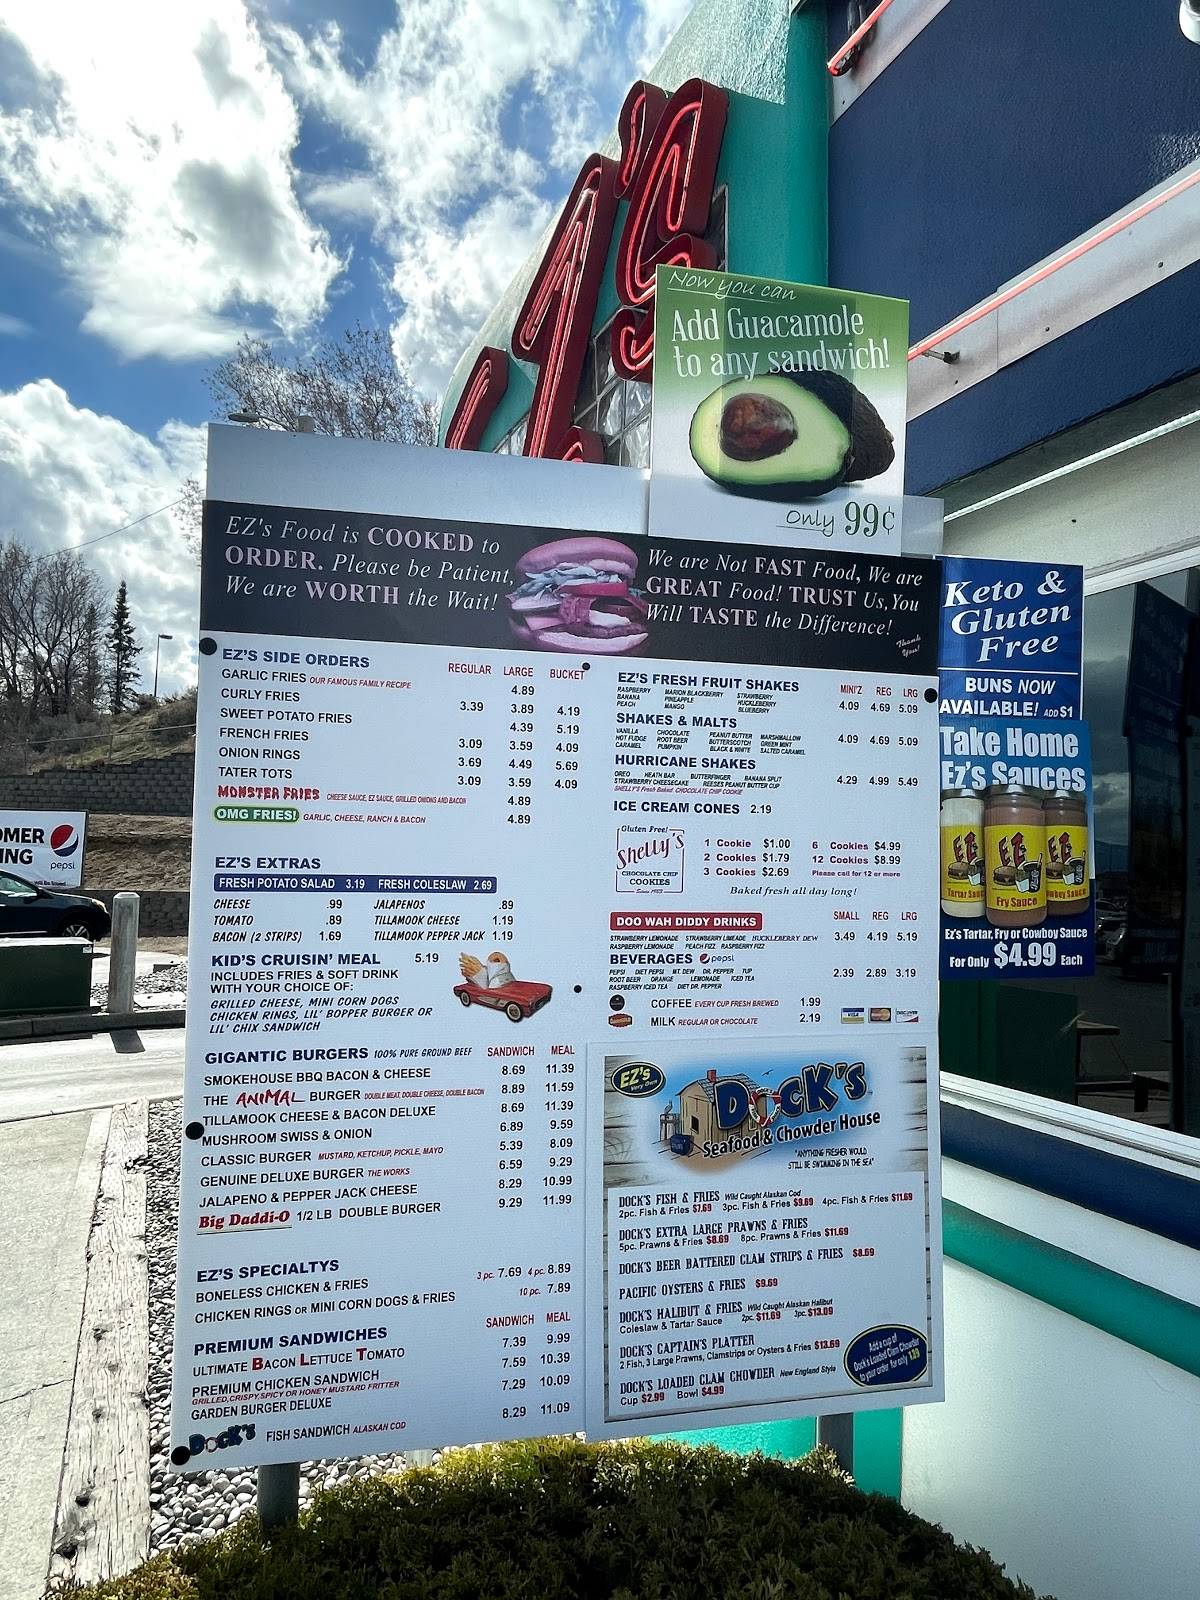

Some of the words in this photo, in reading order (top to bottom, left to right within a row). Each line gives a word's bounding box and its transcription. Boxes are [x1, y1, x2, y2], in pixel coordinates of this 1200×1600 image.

[668, 270, 715, 289] Now
[718, 277, 755, 299] you
[759, 284, 798, 301] can
[671, 309, 720, 342] Add
[727, 304, 865, 340] Guacamole
[674, 348, 701, 378] to
[710, 348, 758, 380] any
[769, 338, 891, 374] sandwich!
[786, 508, 835, 537] Only
[844, 501, 896, 537] 99¢
[224, 515, 272, 539] EZ's
[281, 519, 335, 543] Food
[343, 524, 359, 544] is
[367, 526, 474, 552] COOKED
[481, 536, 501, 555] to
[224, 545, 324, 571] ORDER.
[332, 552, 400, 576] Please
[407, 559, 432, 579] be
[438, 561, 515, 586] Patient,
[648, 549, 673, 568] We
[679, 556, 709, 571] are
[715, 554, 747, 573] Not
[754, 556, 806, 577] FAST
[812, 561, 862, 582] Food,
[867, 566, 891, 584] We
[896, 571, 923, 587] are
[224, 575, 255, 595] We
[262, 583, 298, 598] are
[304, 580, 399, 605] WORTH
[408, 591, 439, 608] the
[448, 589, 499, 611] Wait!
[646, 576, 722, 598] GREAT
[729, 581, 782, 602] Food!
[789, 586, 857, 607] TRUST
[943, 580, 1024, 608] Keto
[1037, 570, 1066, 595] &
[646, 603, 682, 622] Will
[689, 607, 758, 627] TASTE
[764, 612, 791, 629] the
[798, 613, 892, 636] Difference!
[951, 604, 1071, 636] Gluten
[222, 648, 259, 663] EZ'S
[262, 650, 301, 666] SIDE
[305, 653, 370, 669] ORDERS
[976, 635, 1059, 663] Free
[221, 668, 268, 682] GARLIC
[271, 671, 307, 684] FRIES
[309, 676, 325, 685] OUR
[326, 678, 357, 687] FAMOUS
[358, 679, 385, 689] FAMILY
[386, 680, 412, 689] RECIPE
[448, 662, 492, 675] REGULAR
[503, 666, 534, 678] LARGE
[549, 668, 585, 681] BUCKET
[618, 671, 649, 685] EZ'S
[652, 673, 698, 687] FRESH
[701, 676, 742, 689] FRUIT
[746, 679, 800, 692] SHAKES
[876, 686, 892, 697] REG
[903, 688, 919, 699] LRG
[965, 677, 1012, 693] BUNS
[1018, 680, 1056, 695] NOW
[839, 700, 860, 712] 4.09
[870, 702, 891, 713] 4.69
[899, 704, 919, 714] 5.09
[939, 699, 1039, 717] AVAILABLE!
[1043, 709, 1058, 717] ADD
[1060, 705, 1073, 718] $1
[940, 726, 1000, 757] Take
[1006, 727, 1079, 758] Home
[942, 761, 986, 791] Ez's
[992, 761, 1086, 792] Sauces
[216, 808, 249, 821] OMG
[252, 809, 298, 822] FRIES!
[507, 813, 531, 826] 4.89
[613, 800, 637, 813] ICE
[640, 801, 690, 814] CREAM
[694, 802, 740, 815] CONES
[750, 803, 772, 815] 2.19
[50, 861, 75, 871] pepsi
[219, 877, 255, 889] FRESH
[256, 878, 298, 889] POTATO
[300, 878, 336, 889] SALAD
[345, 879, 365, 890] 3.19
[378, 879, 411, 891] FRESH
[412, 879, 467, 891] COLESLAW
[472, 880, 492, 891] 2.69
[616, 916, 646, 927] DOO
[649, 916, 672, 927] WAH
[675, 916, 710, 928] DIDDY
[713, 916, 757, 928] DRINKS
[945, 928, 962, 940] Ez's
[964, 928, 993, 940] Tartar,
[995, 928, 1009, 941] Fry
[1011, 930, 1020, 939] or
[1022, 927, 1058, 940] Cowboy
[1059, 927, 1088, 939] Sauce
[211, 954, 256, 967] KID'S
[260, 952, 333, 967] CRUISIN'
[338, 952, 381, 966] MEAL
[414, 952, 439, 964] 5.19
[610, 953, 693, 965] BEVERAGES
[710, 953, 735, 964] pepsi
[950, 956, 966, 968] For
[968, 956, 990, 969] Only
[994, 941, 1057, 969] $4.99
[1061, 954, 1083, 966] Each
[205, 1050, 288, 1065] GIGANTIC
[292, 1047, 369, 1062] BURGERS
[373, 1049, 398, 1059] 100%
[399, 1048, 420, 1058] PURE
[421, 1048, 452, 1058] GROUND
[454, 1046, 473, 1057] BEEF
[486, 1046, 535, 1058] SANDWICH
[551, 1044, 575, 1056] MEAL
[204, 1072, 293, 1088] SMOKEHOUSE
[296, 1070, 322, 1084] BBQ
[325, 1069, 368, 1081] BACON
[371, 1069, 381, 1080] &
[383, 1067, 431, 1079] CHEESE
[502, 1064, 526, 1076] 8.69
[546, 1063, 574, 1075] 11.39
[702, 1133, 762, 1158] Seafood
[763, 1132, 773, 1145] &
[776, 1119, 837, 1143] Chowder
[839, 1110, 881, 1130] House
[656, 1193, 678, 1205] FISH
[682, 1193, 688, 1203] &
[693, 1191, 720, 1202] FRIES
[199, 1212, 225, 1231] Big
[228, 1209, 290, 1226] Daddi-O
[193, 1335, 274, 1356] PREMIUM
[278, 1326, 388, 1348] SANDWICHES
[621, 1396, 638, 1406] Cup
[641, 1392, 665, 1404] $2.99
[677, 1389, 698, 1400] Bowl
[701, 1386, 724, 1398] $4.99
[266, 1428, 291, 1443] FISH
[293, 1422, 351, 1440] SANDWICH
[352, 1420, 388, 1434] ALASKAN
[390, 1420, 406, 1432] COD
[502, 1405, 527, 1420] 8.29
[540, 1401, 570, 1415] 11.09
